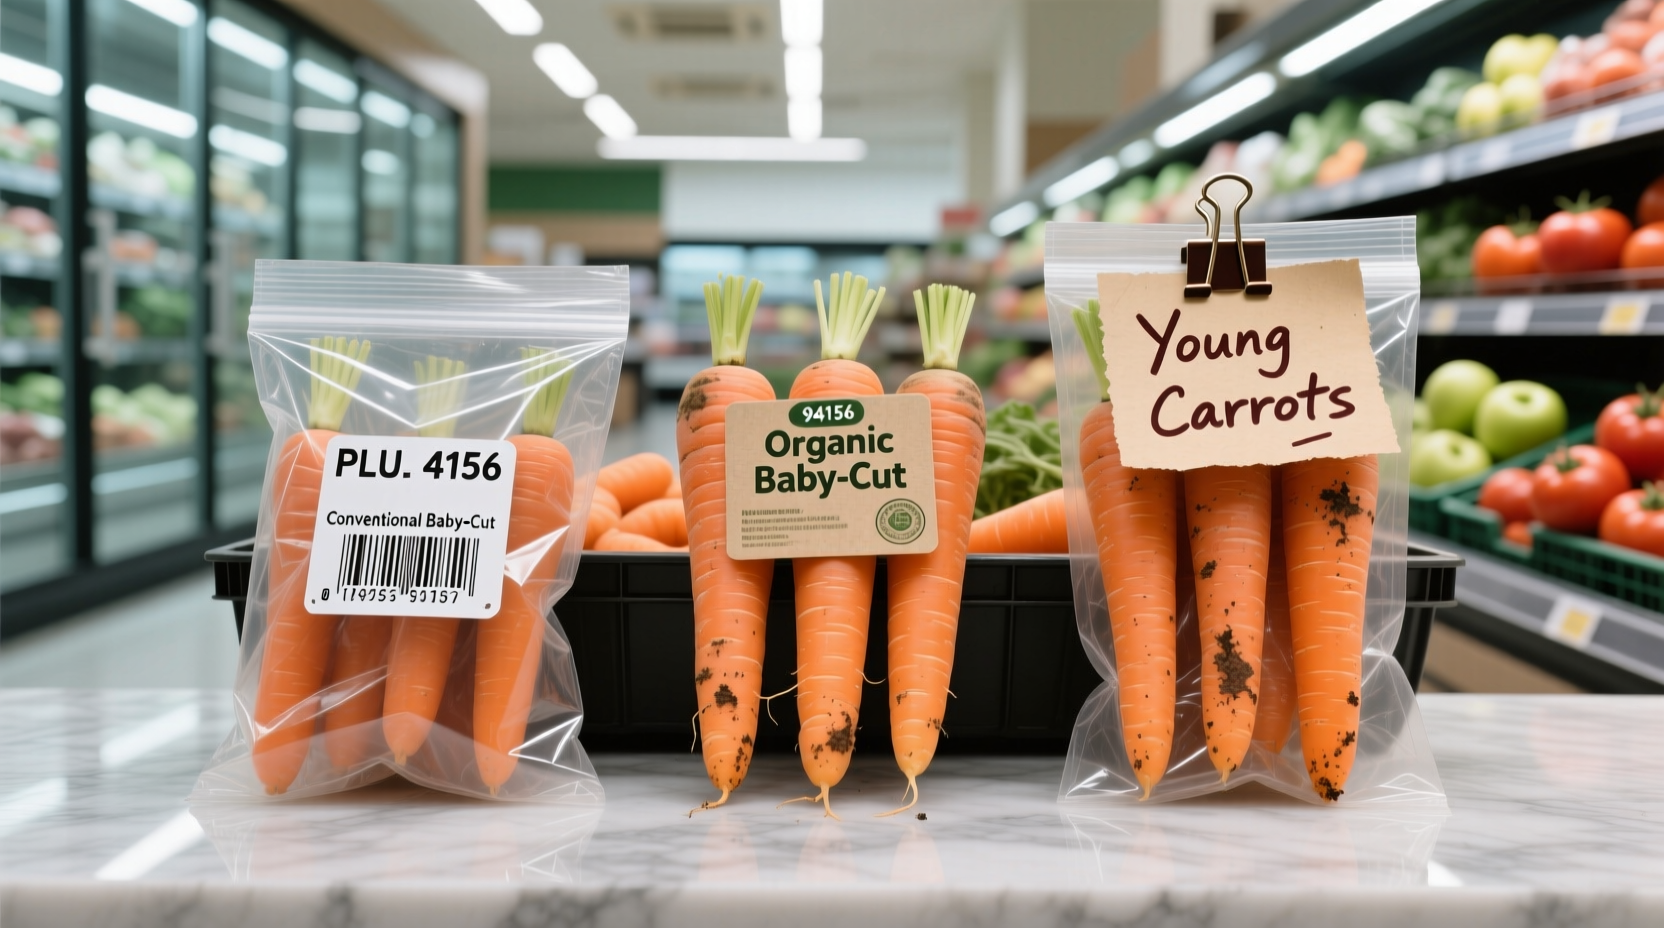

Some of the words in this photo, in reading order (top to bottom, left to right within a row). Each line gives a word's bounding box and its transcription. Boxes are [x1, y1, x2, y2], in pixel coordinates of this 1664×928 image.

[1136, 308, 1290, 379] Young
[802, 404, 855, 423] 94156
[1150, 372, 1356, 437] Carrots
[764, 424, 895, 464] Organic
[335, 448, 411, 479] PLU.
[422, 450, 502, 482] 4156
[754, 461, 908, 500] Baby-Cut
[326, 510, 422, 528] Conventional
[425, 512, 496, 532] Baby-Cut
